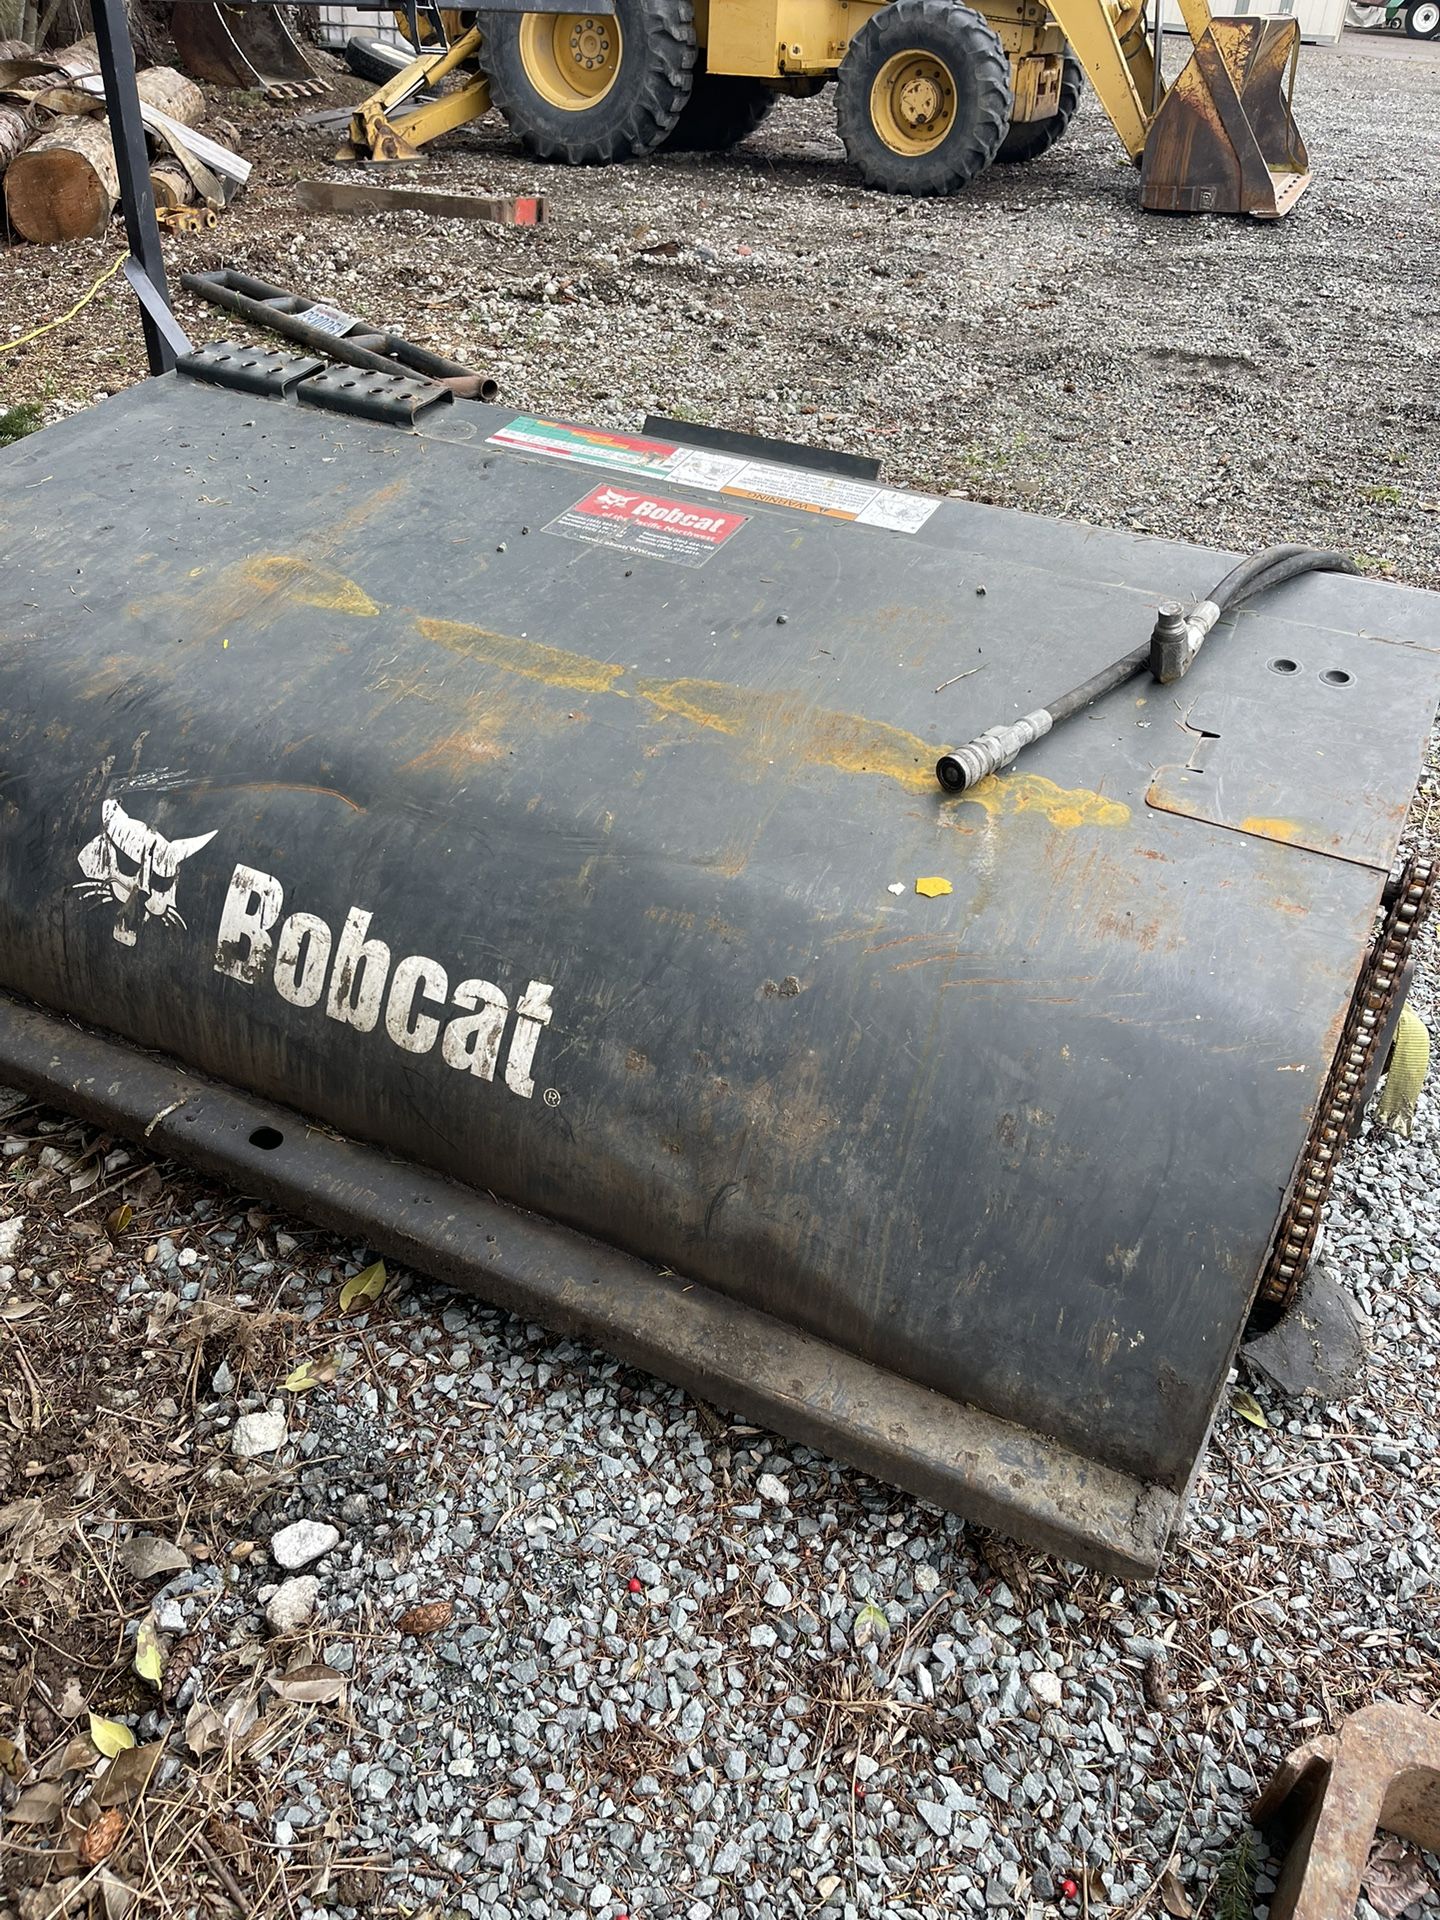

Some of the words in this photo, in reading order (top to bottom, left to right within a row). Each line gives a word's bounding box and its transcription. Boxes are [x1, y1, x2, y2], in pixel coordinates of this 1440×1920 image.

[747, 492, 808, 509] WARNING
[631, 500, 726, 533] Bobcat
[663, 525, 717, 542] Northwest
[214, 863, 554, 1099] Bobcat
